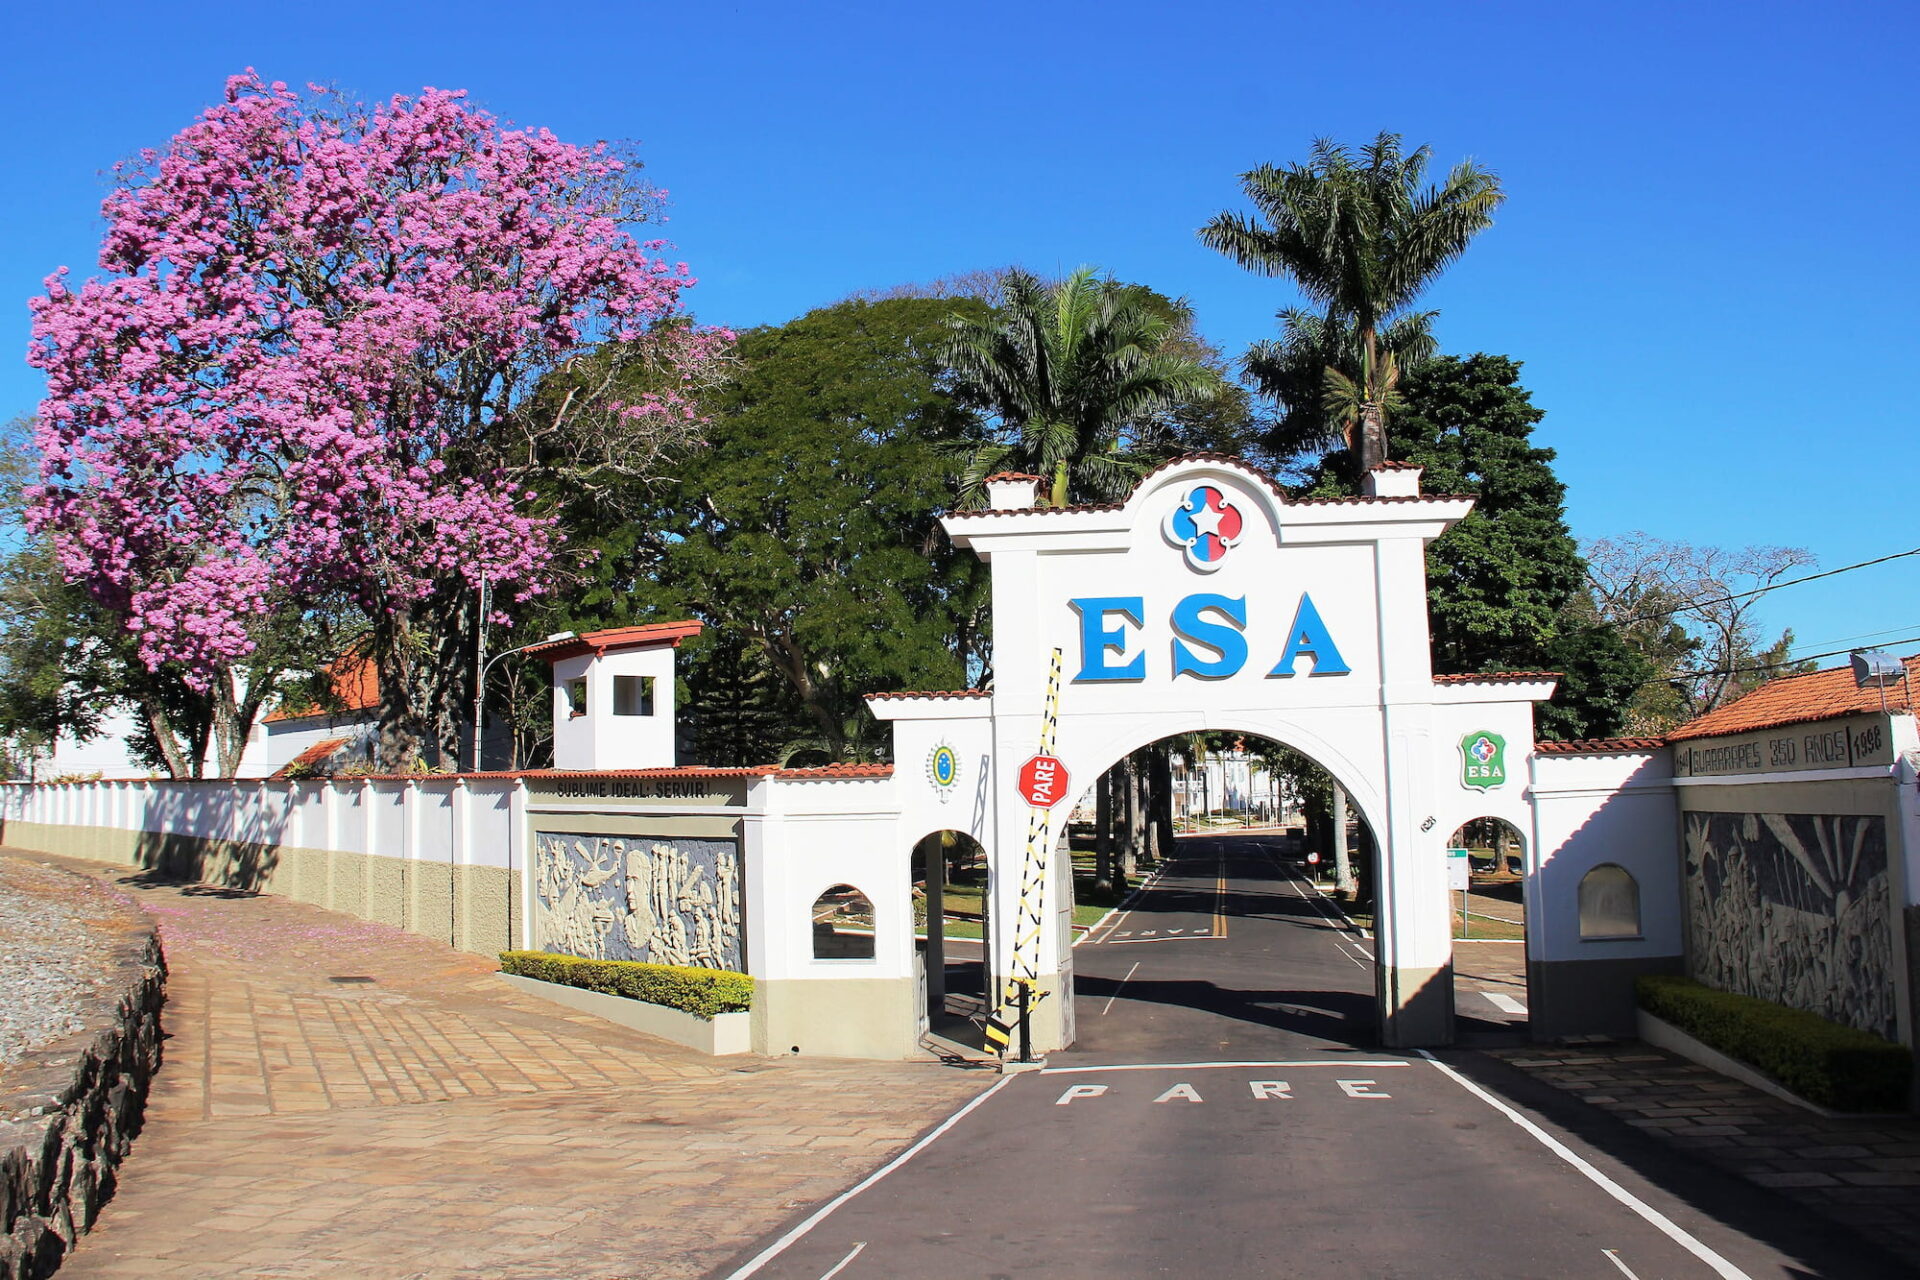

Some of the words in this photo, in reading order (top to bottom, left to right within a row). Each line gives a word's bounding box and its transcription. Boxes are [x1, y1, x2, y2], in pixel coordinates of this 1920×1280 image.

[1067, 591, 1351, 685] ESA
[1692, 741, 1762, 773] GUARARAPES
[1769, 738, 1796, 767] 350
[1804, 730, 1846, 763] ANOS
[1853, 725, 1882, 759] 1998
[1031, 760, 1057, 803] PARE
[1467, 765, 1503, 778] ESA
[557, 782, 607, 797] SUBLIME
[1055, 1079, 1392, 1105] PARE
